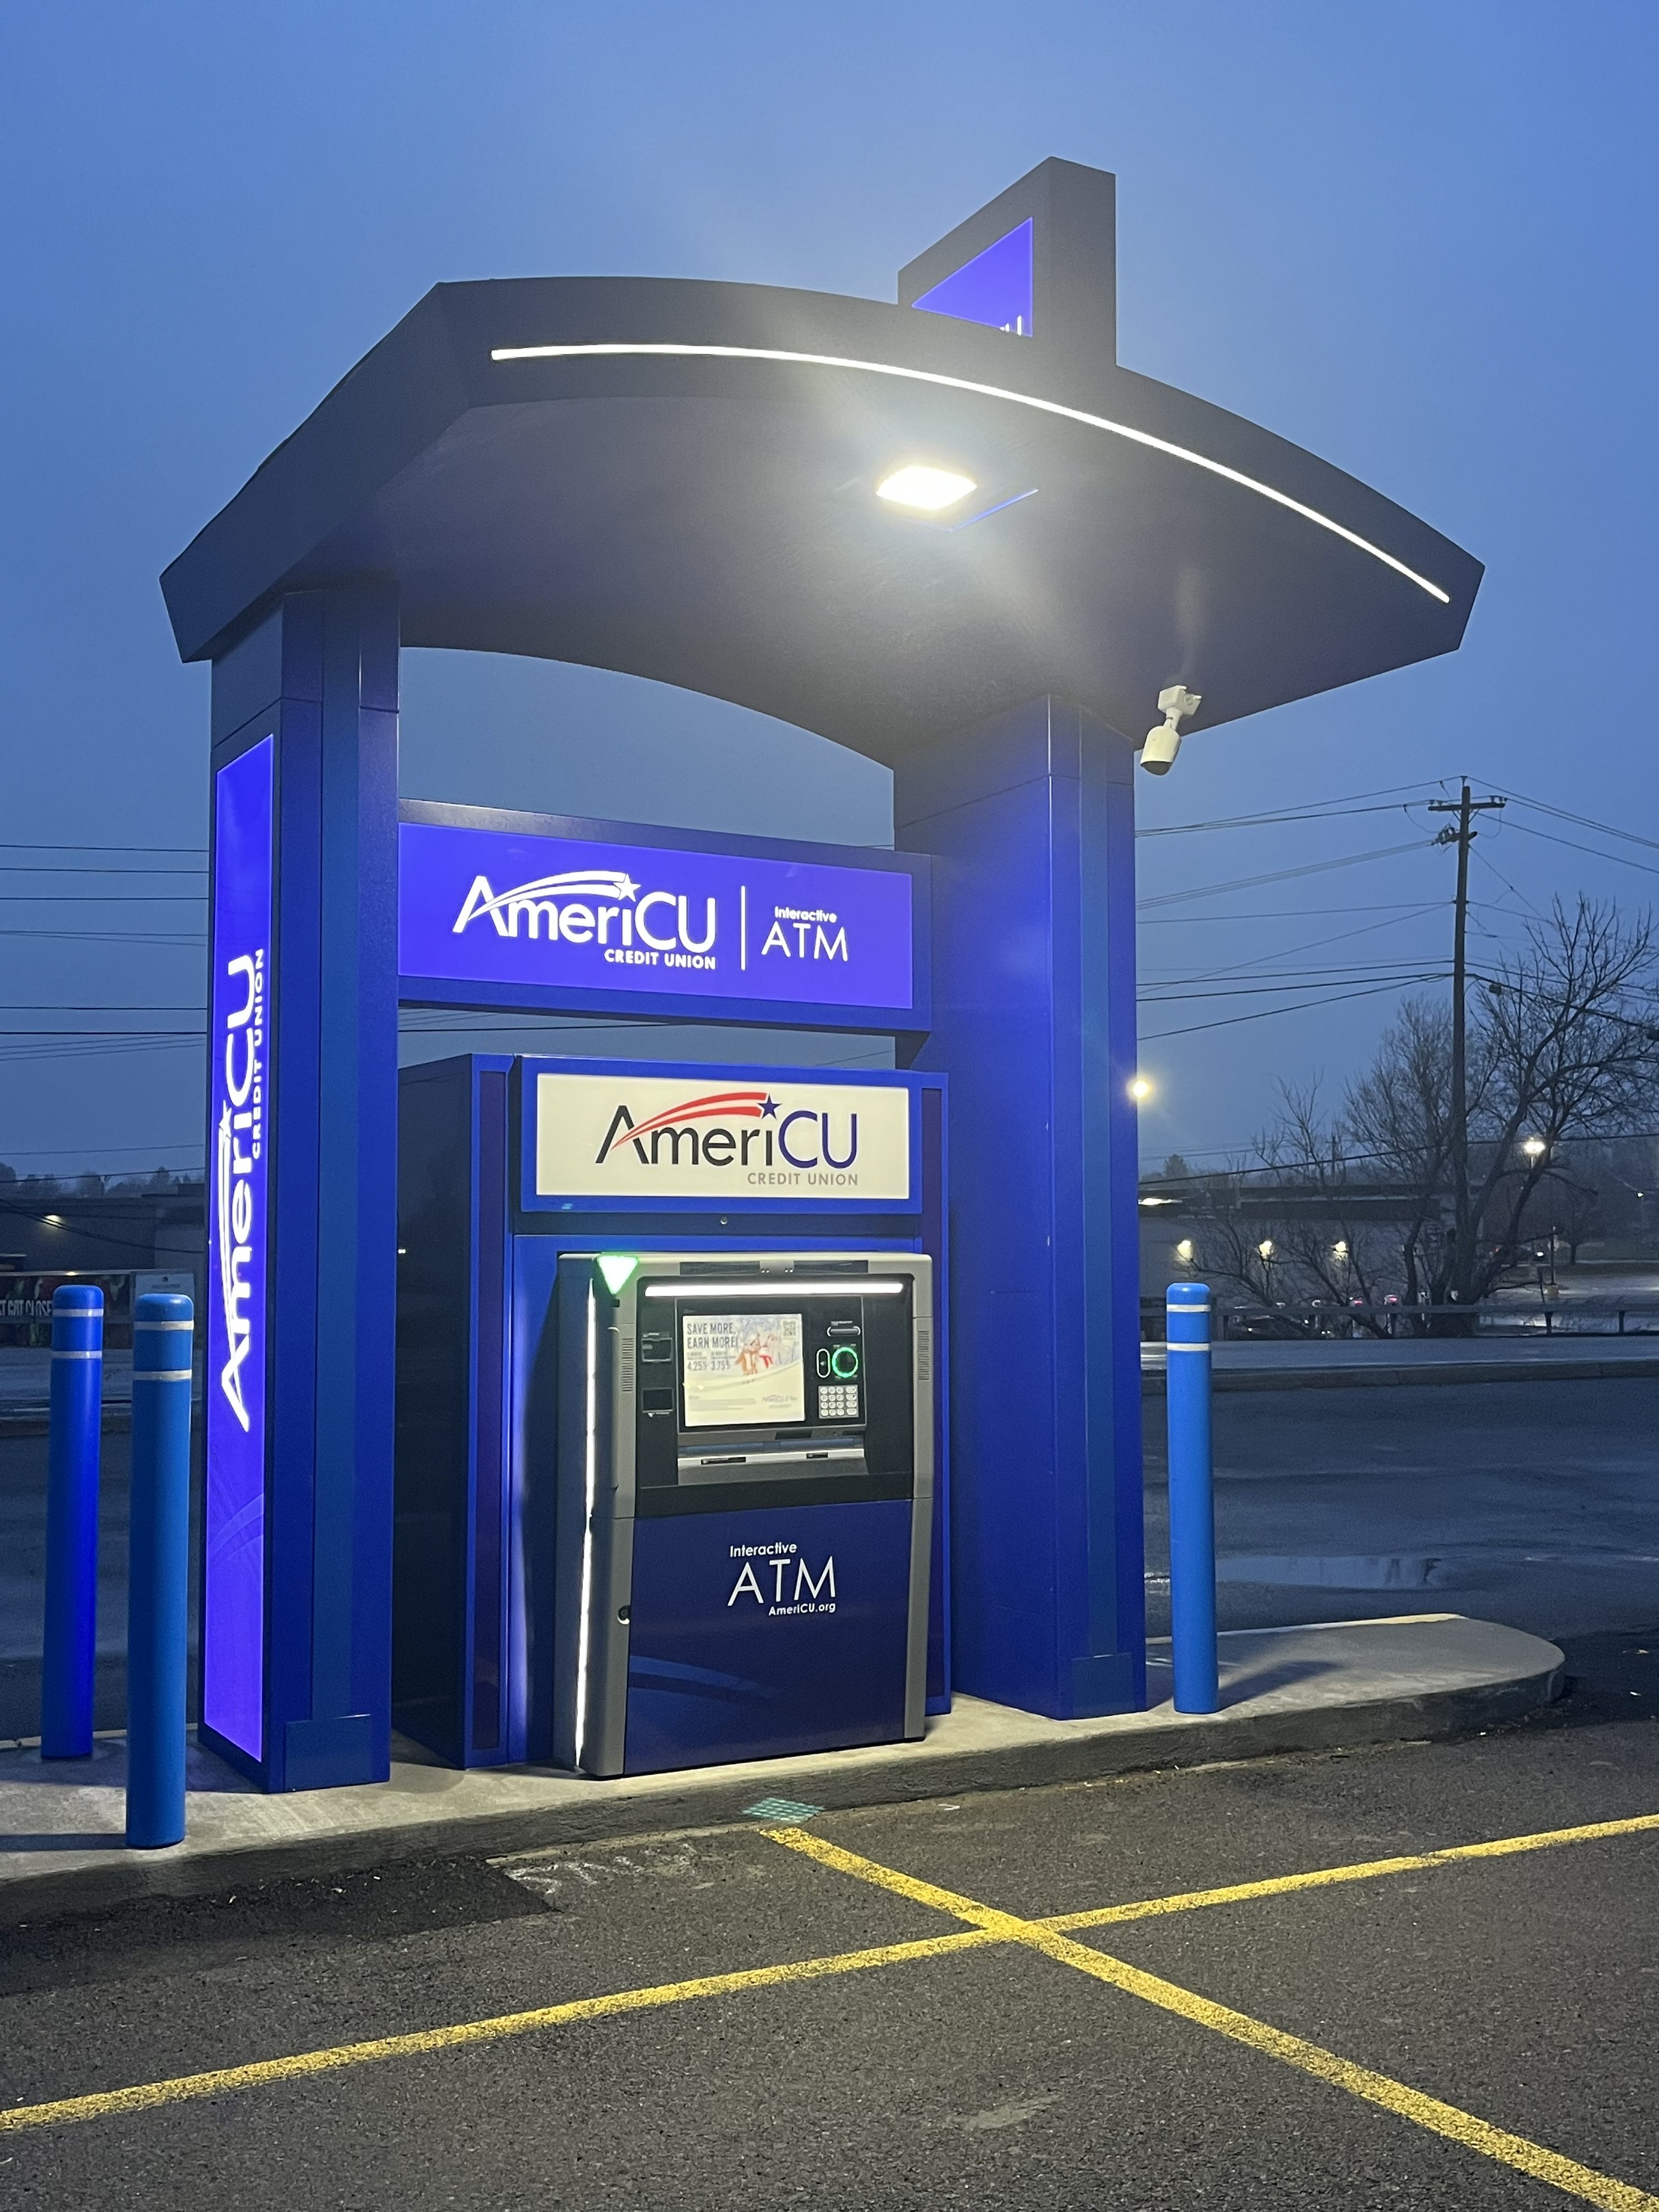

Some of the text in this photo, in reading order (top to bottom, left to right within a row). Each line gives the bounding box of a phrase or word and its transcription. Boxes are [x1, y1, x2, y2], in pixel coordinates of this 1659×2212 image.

[453, 872, 716, 953] AmeriCU
[774, 906, 838, 923] Interactive
[761, 921, 848, 962] ATM
[604, 949, 716, 970] CREDIT UNION
[252, 949, 264, 1159] CREDIT UNION
[595, 1097, 857, 1169] AmeriCU
[747, 1172, 857, 1186] CREDIT UNION
[221, 955, 255, 1433] AmeriCU
[687, 1323, 707, 1334] SAVE
[687, 1337, 709, 1348] EARN
[730, 1542, 797, 1558] Interactive
[727, 1556, 836, 1606] ATM
[769, 1603, 836, 1616] AmeriCU.org
